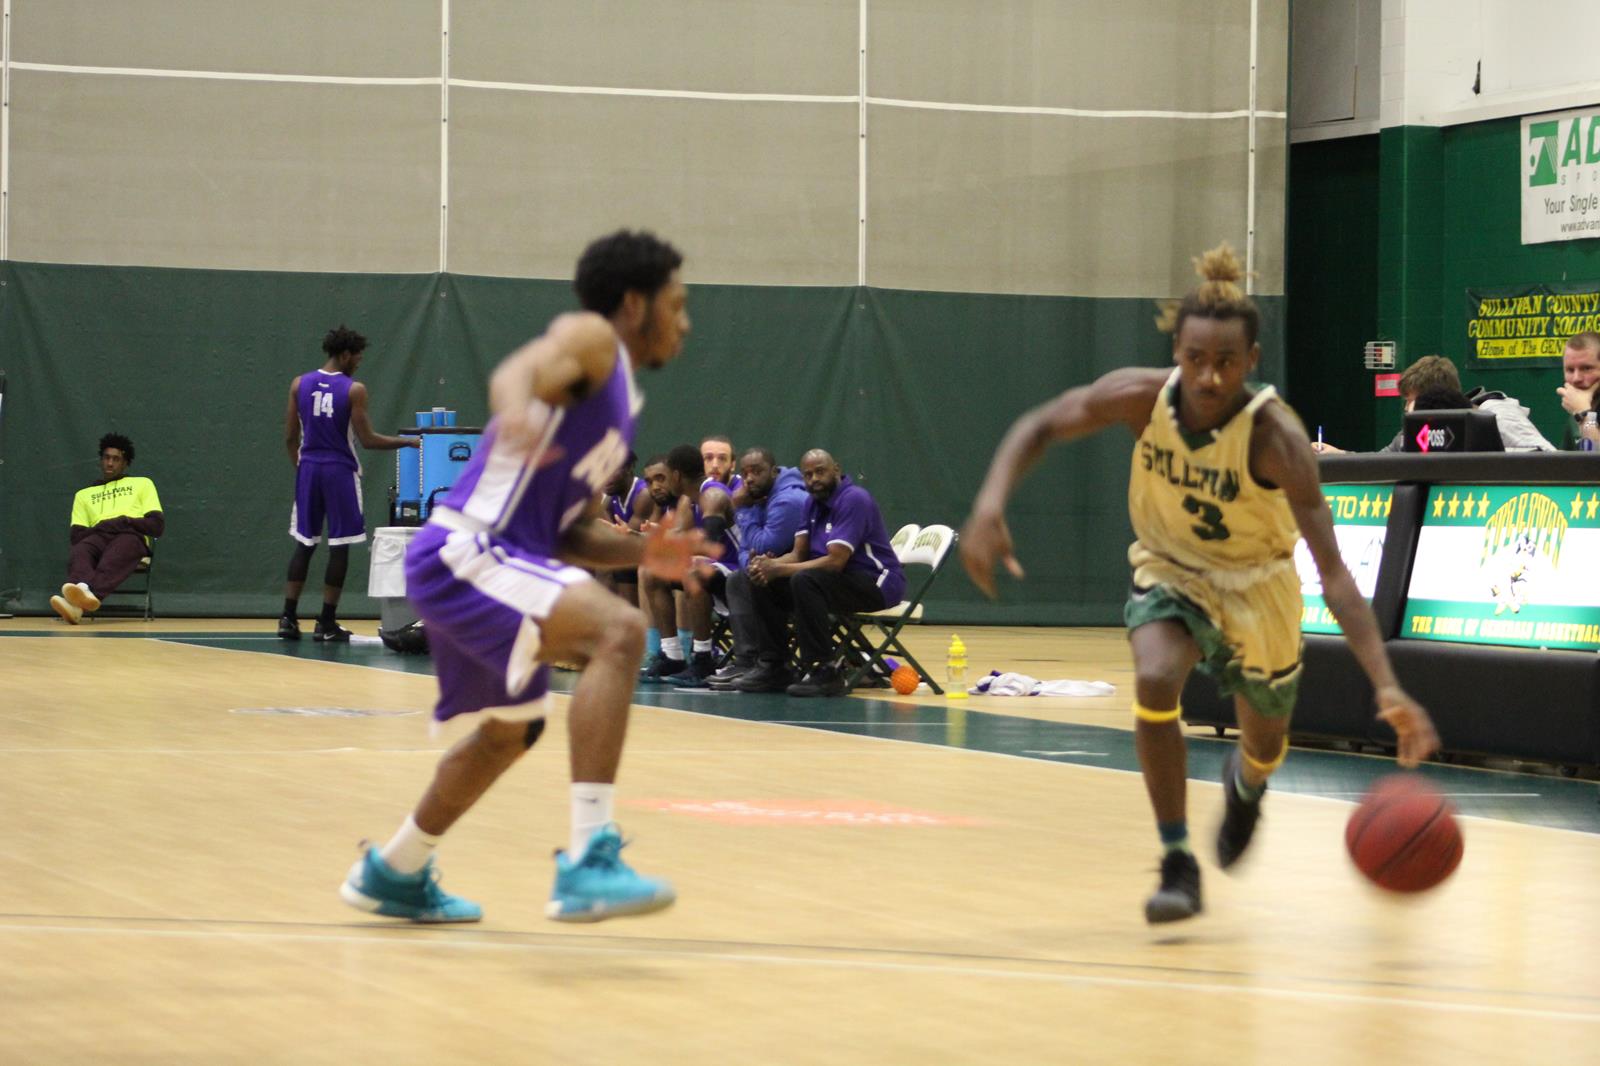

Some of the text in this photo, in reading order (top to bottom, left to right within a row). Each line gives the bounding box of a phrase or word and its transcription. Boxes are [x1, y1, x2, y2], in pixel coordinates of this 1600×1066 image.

[1544, 192, 1599, 216] Your Single
[1478, 293, 1600, 317] SULLIVAN COUNTY
[1468, 316, 1551, 338] COMMUNITY
[1479, 341, 1505, 356] Home
[1508, 340, 1519, 355] of
[1521, 340, 1537, 355] The
[311, 390, 334, 418] 14
[1427, 428, 1445, 447] POSS
[91, 485, 133, 501] SULLIVAN
[1182, 494, 1231, 541] 3
[1336, 495, 1357, 519] TO
